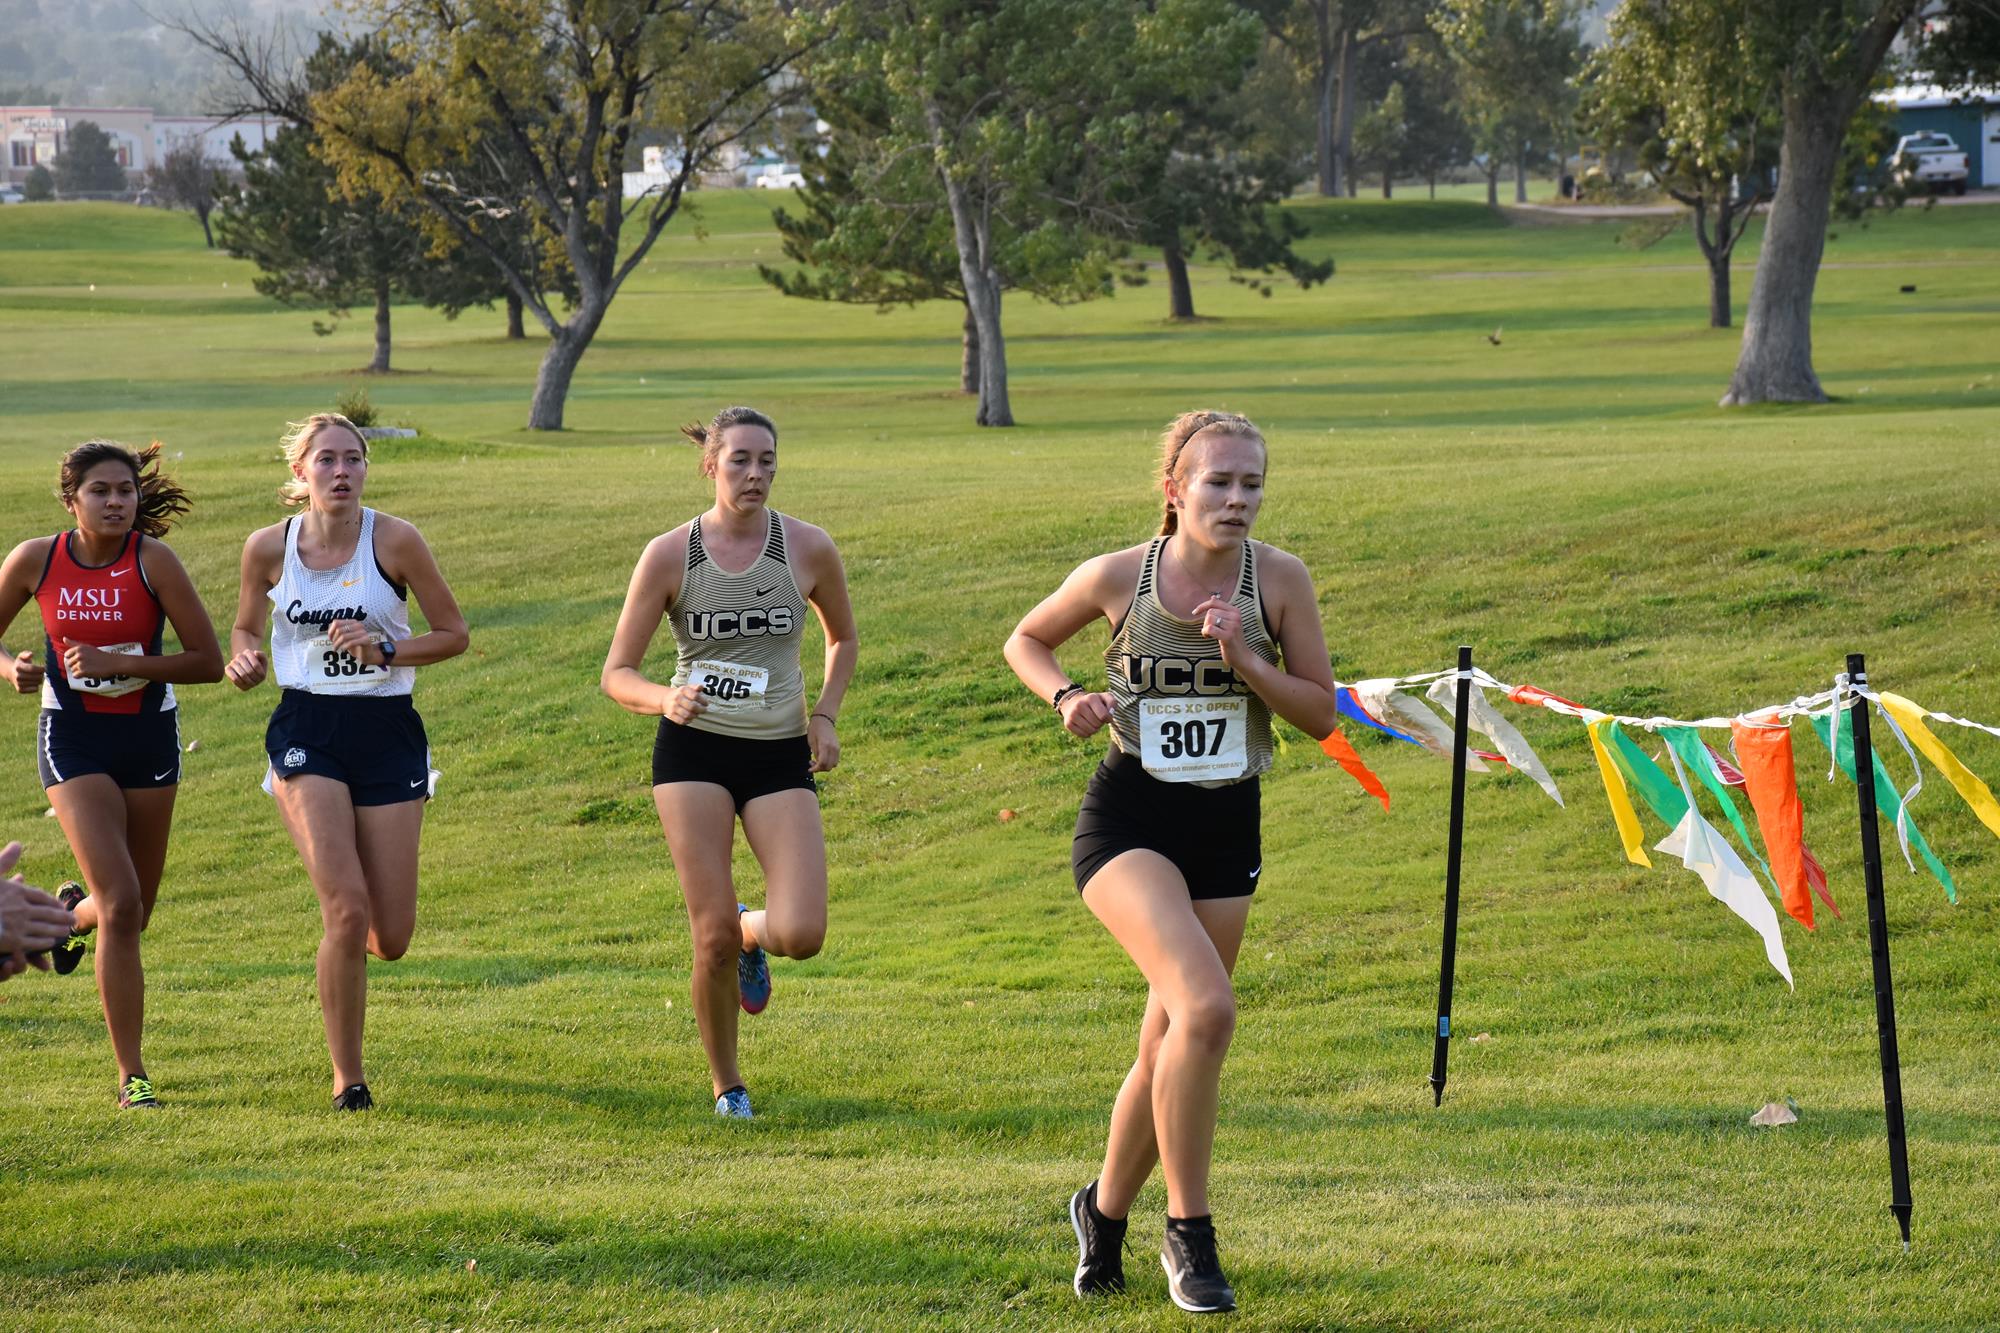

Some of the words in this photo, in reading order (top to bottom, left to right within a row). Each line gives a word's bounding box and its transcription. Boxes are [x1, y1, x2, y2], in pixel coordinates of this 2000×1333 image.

[58, 587, 120, 607] MSU
[57, 609, 123, 621] DENVER
[286, 600, 367, 631] Cougars
[686, 606, 794, 641] UCCS
[313, 639, 334, 648] UCC
[697, 661, 720, 672] UCCS
[723, 666, 737, 675] XC
[738, 669, 763, 678] OPEN
[702, 674, 752, 701] 305
[1147, 704, 1182, 715] UCCS
[1185, 703, 1203, 714] XC
[1206, 702, 1240, 712] OPEN
[1160, 718, 1227, 759] 307
